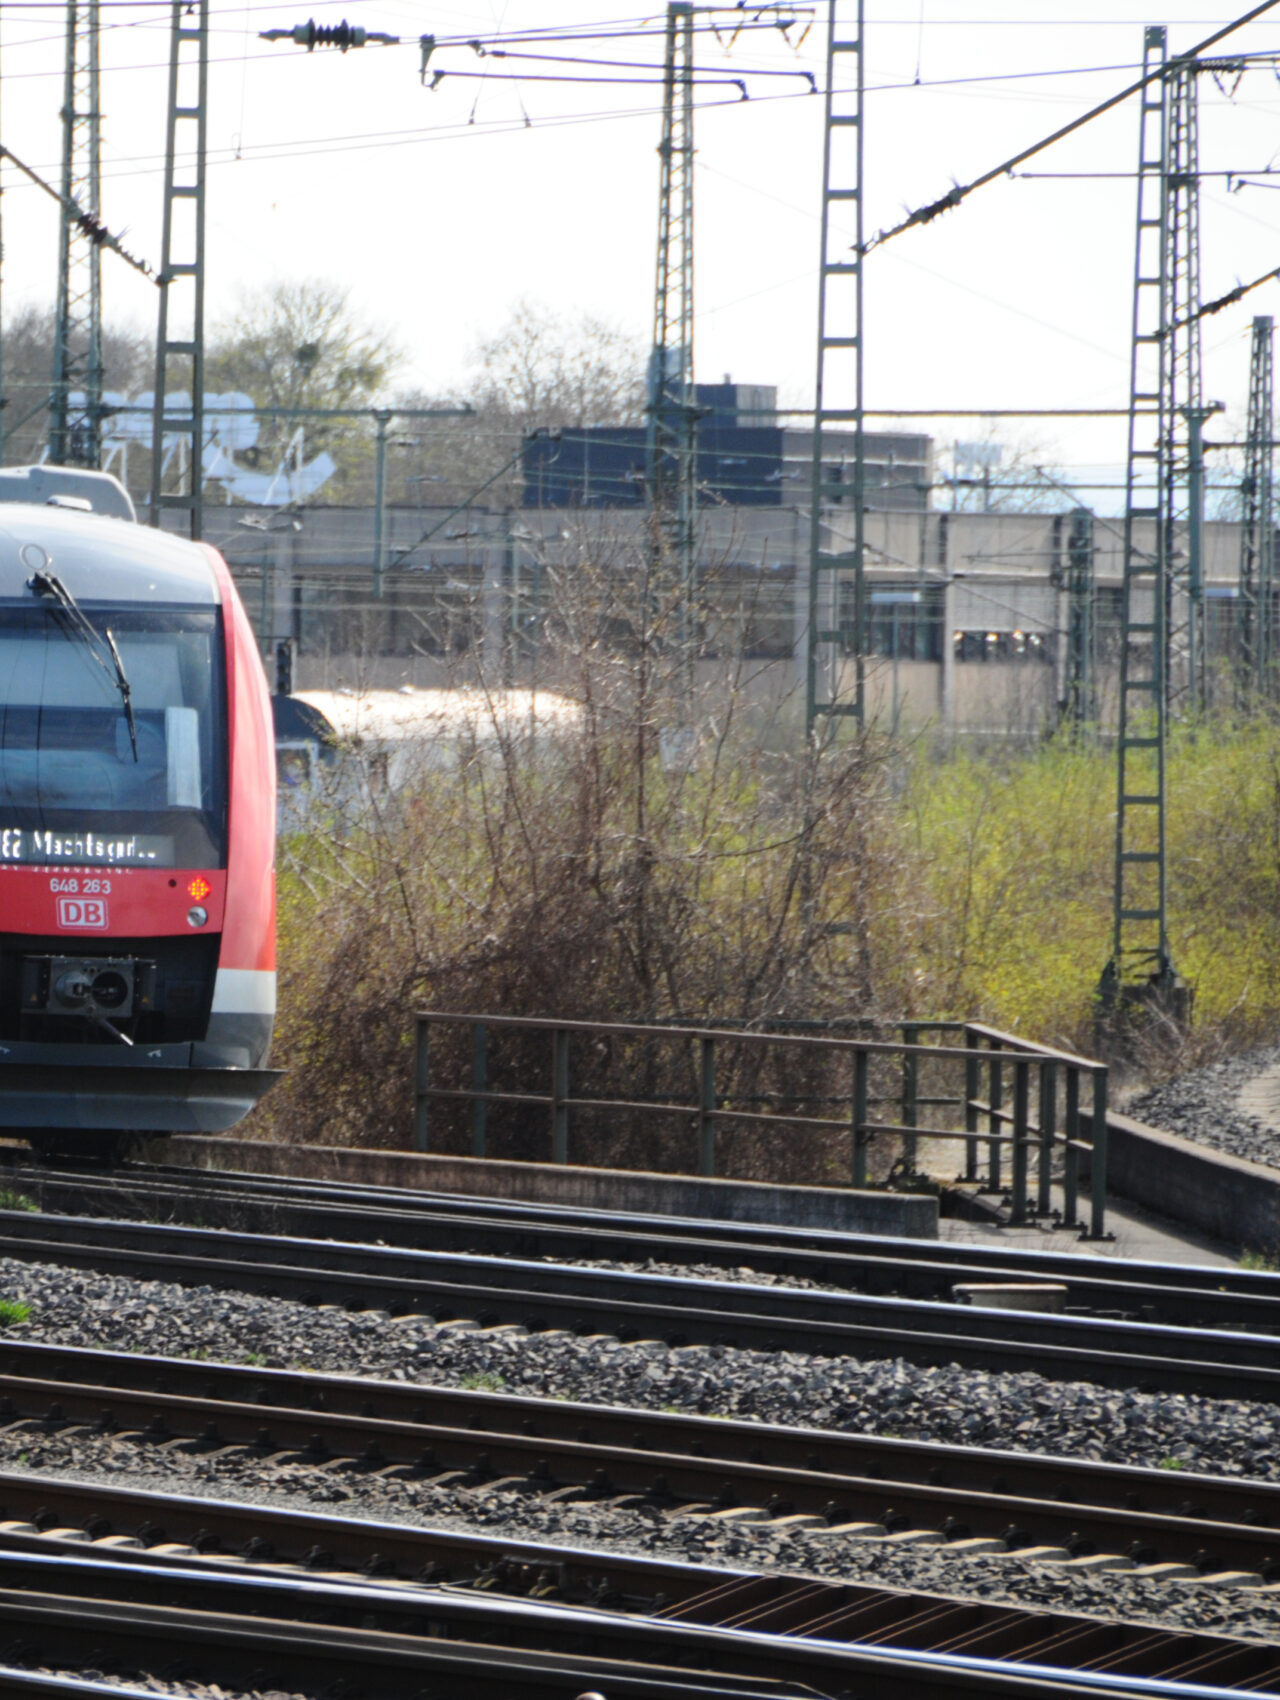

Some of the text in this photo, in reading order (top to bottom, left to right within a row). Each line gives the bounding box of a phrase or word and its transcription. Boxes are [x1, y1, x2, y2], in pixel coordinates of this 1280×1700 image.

[49, 877, 112, 894] 648 263
[63, 902, 102, 924] DB
